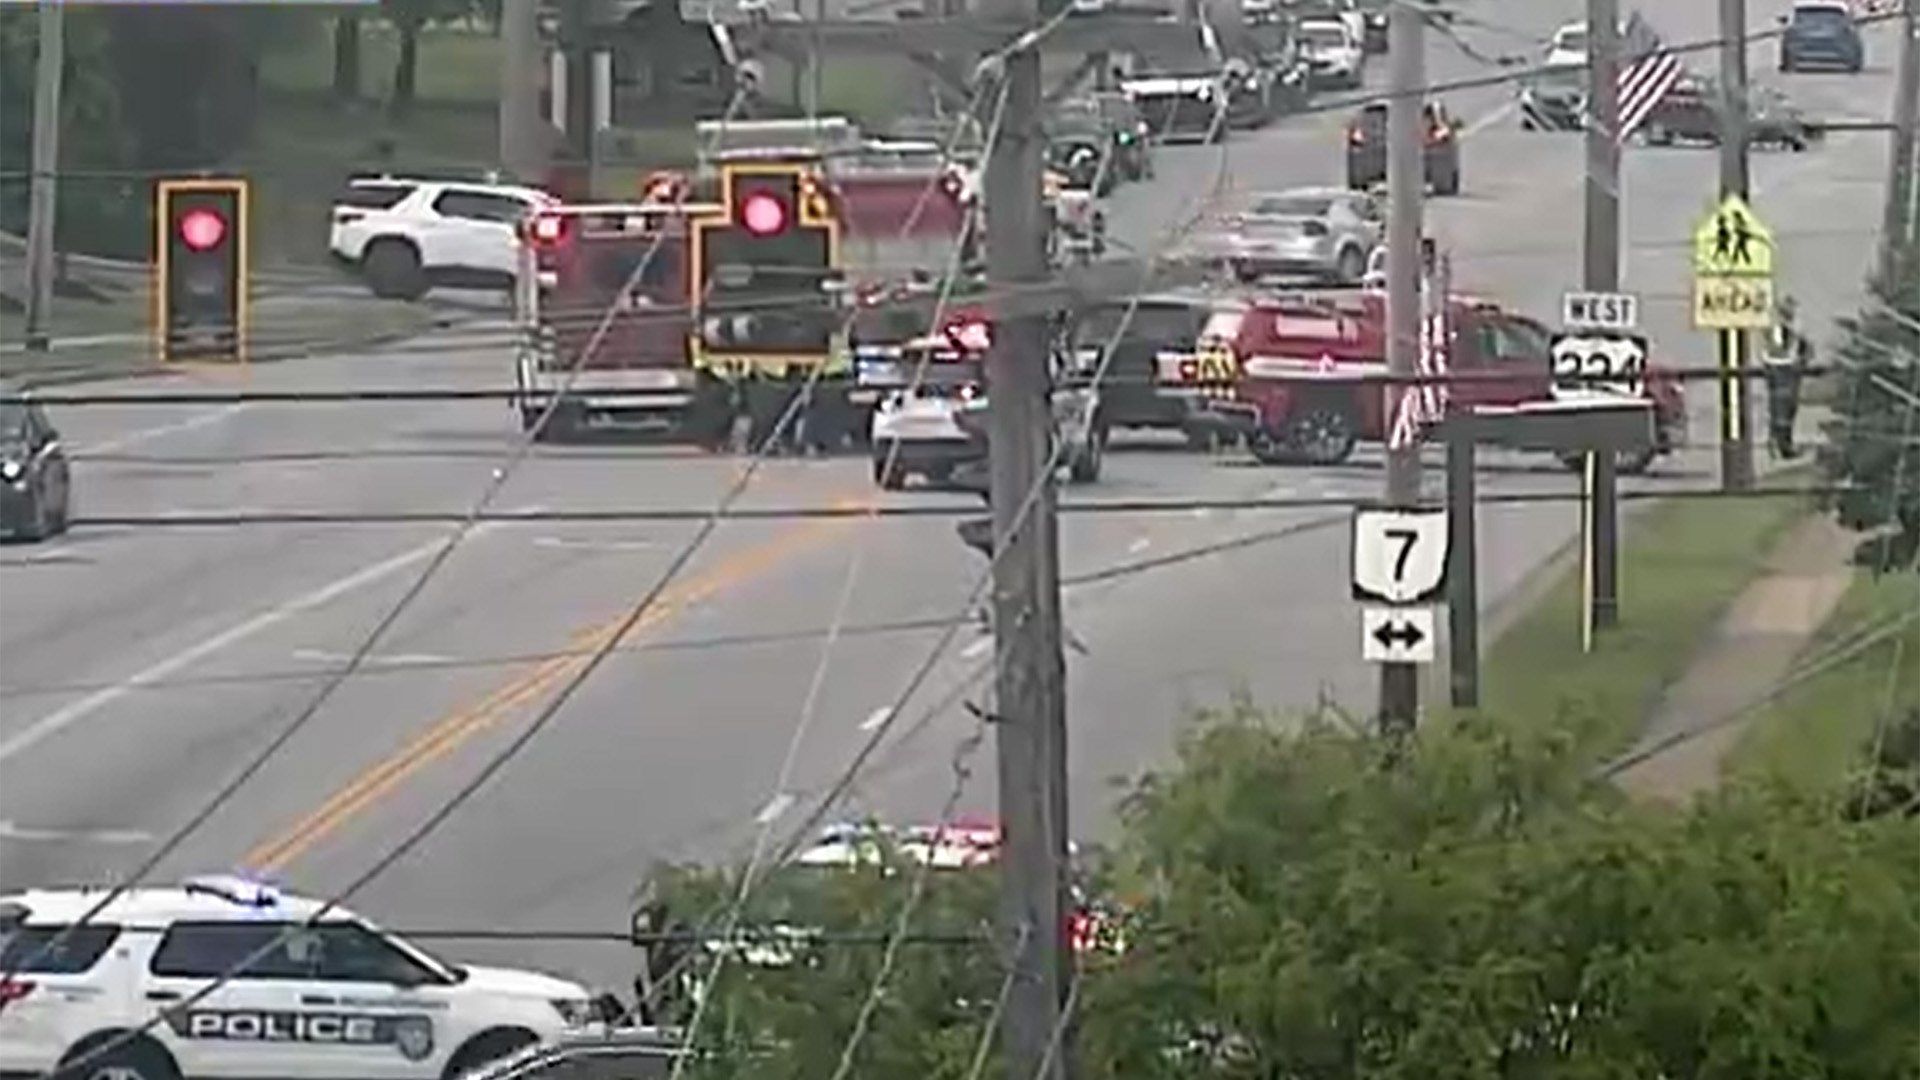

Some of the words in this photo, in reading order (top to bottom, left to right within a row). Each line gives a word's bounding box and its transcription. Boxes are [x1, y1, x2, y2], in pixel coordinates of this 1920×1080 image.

[1570, 299, 1631, 322] WEST
[1557, 351, 1639, 393] 224
[1384, 529, 1418, 582] 7
[190, 1013, 376, 1040] POLICE
